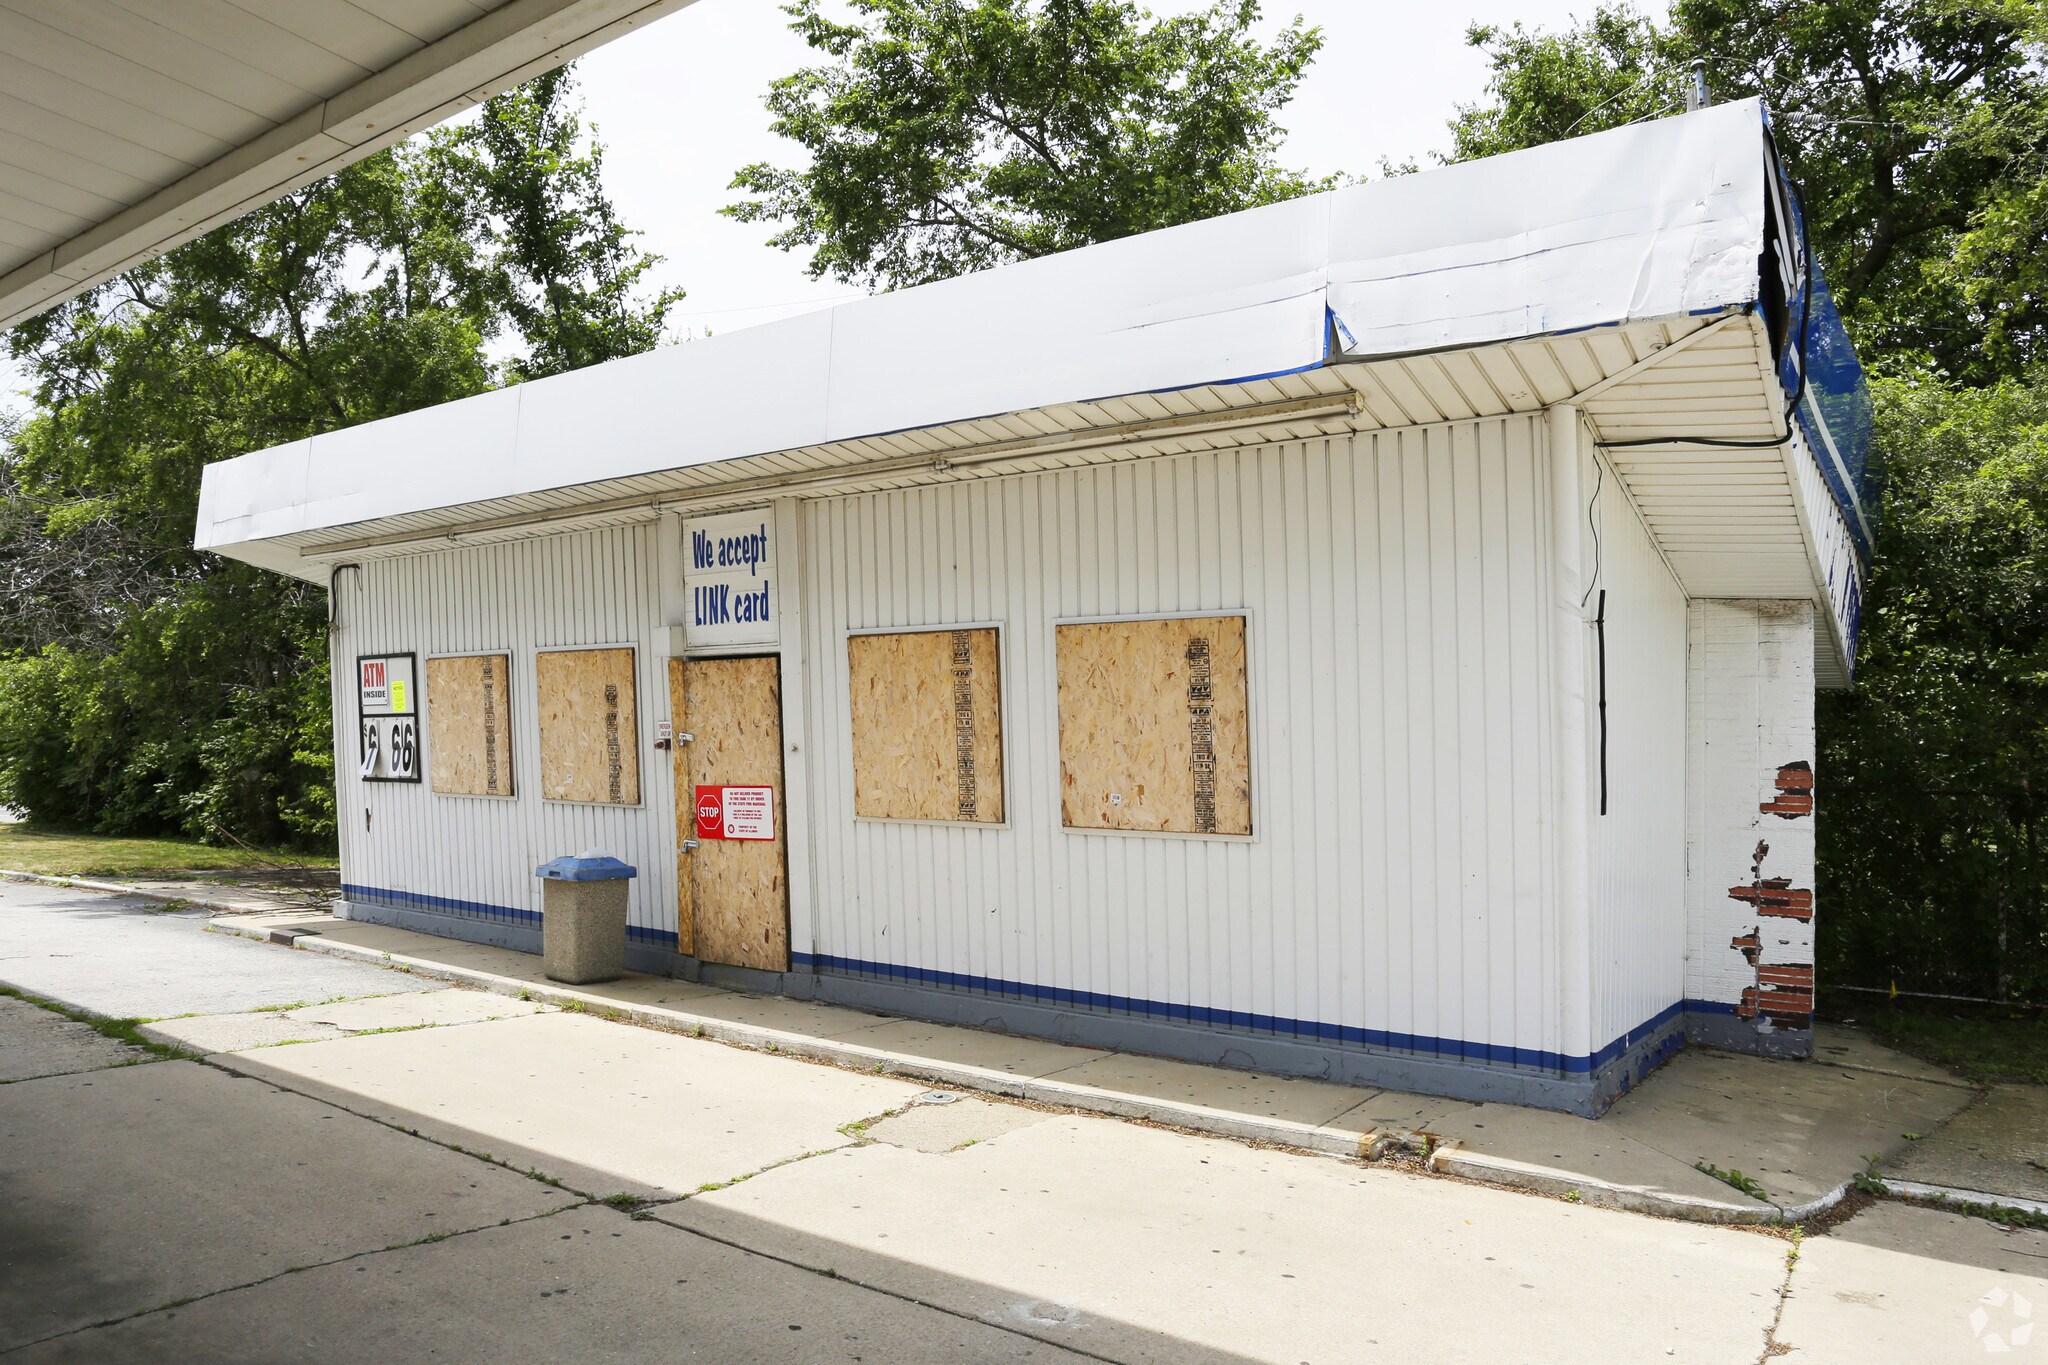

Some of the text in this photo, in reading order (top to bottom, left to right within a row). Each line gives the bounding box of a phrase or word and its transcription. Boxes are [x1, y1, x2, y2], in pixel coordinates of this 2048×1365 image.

[692, 523, 767, 576] We accept
[694, 580, 769, 626] LINK card
[363, 662, 385, 688] ATM
[363, 690, 386, 698] INSIDE
[700, 806, 719, 817] STOP
